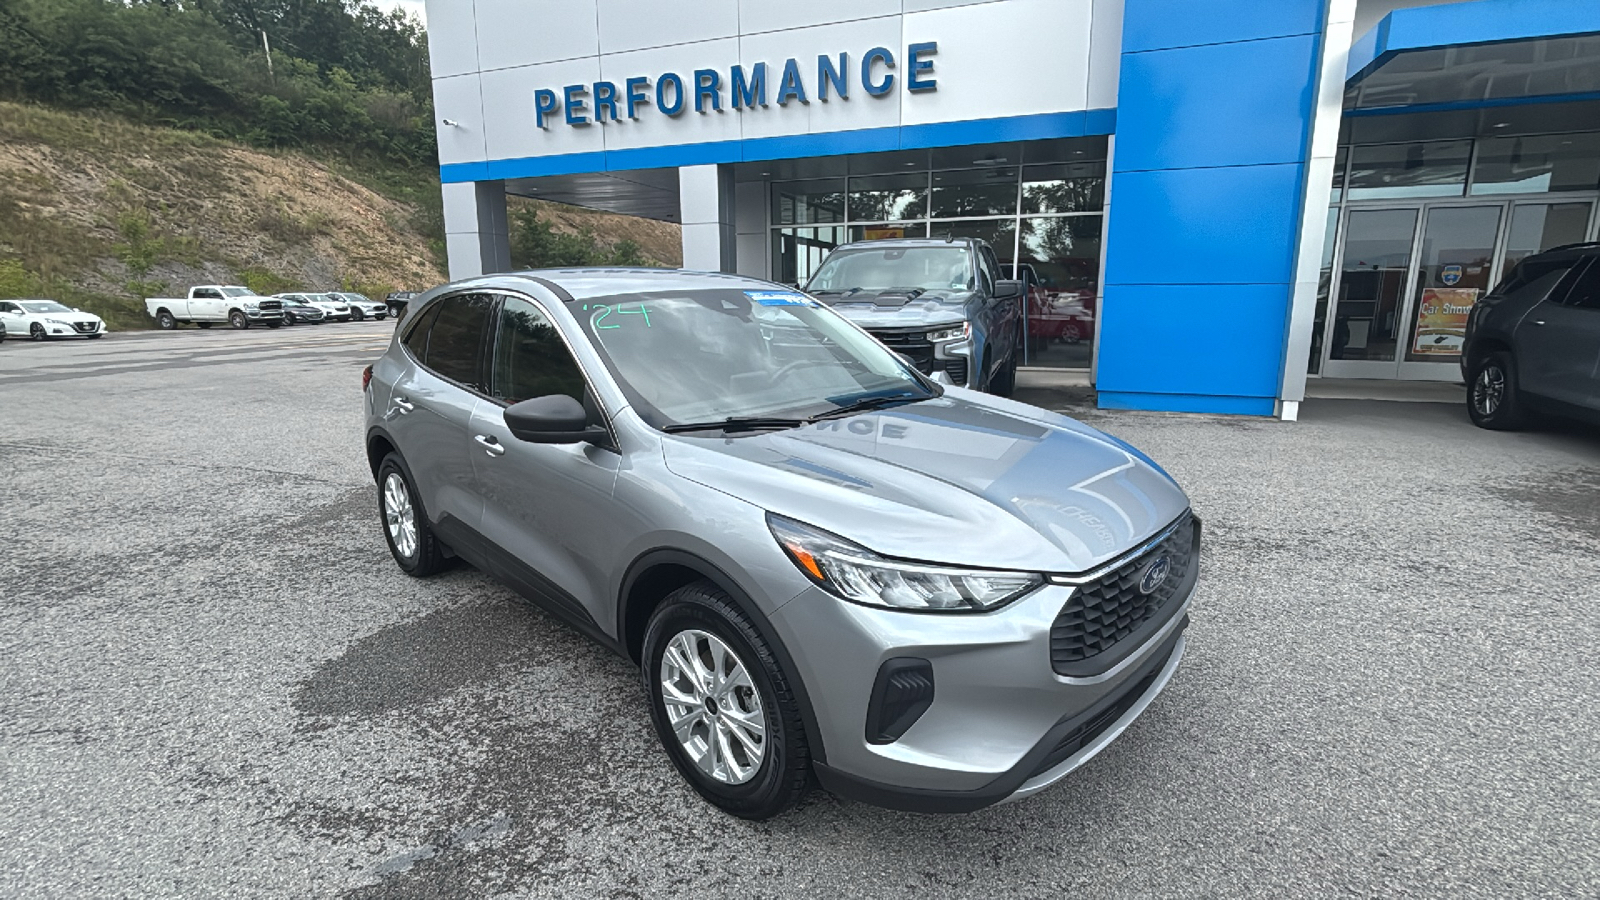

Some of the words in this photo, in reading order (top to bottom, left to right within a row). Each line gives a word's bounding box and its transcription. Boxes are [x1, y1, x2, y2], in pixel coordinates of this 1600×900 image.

[534, 42, 937, 129] PERFORMANCE
[1421, 303, 1439, 314] Car
[1442, 303, 1472, 314] Show
